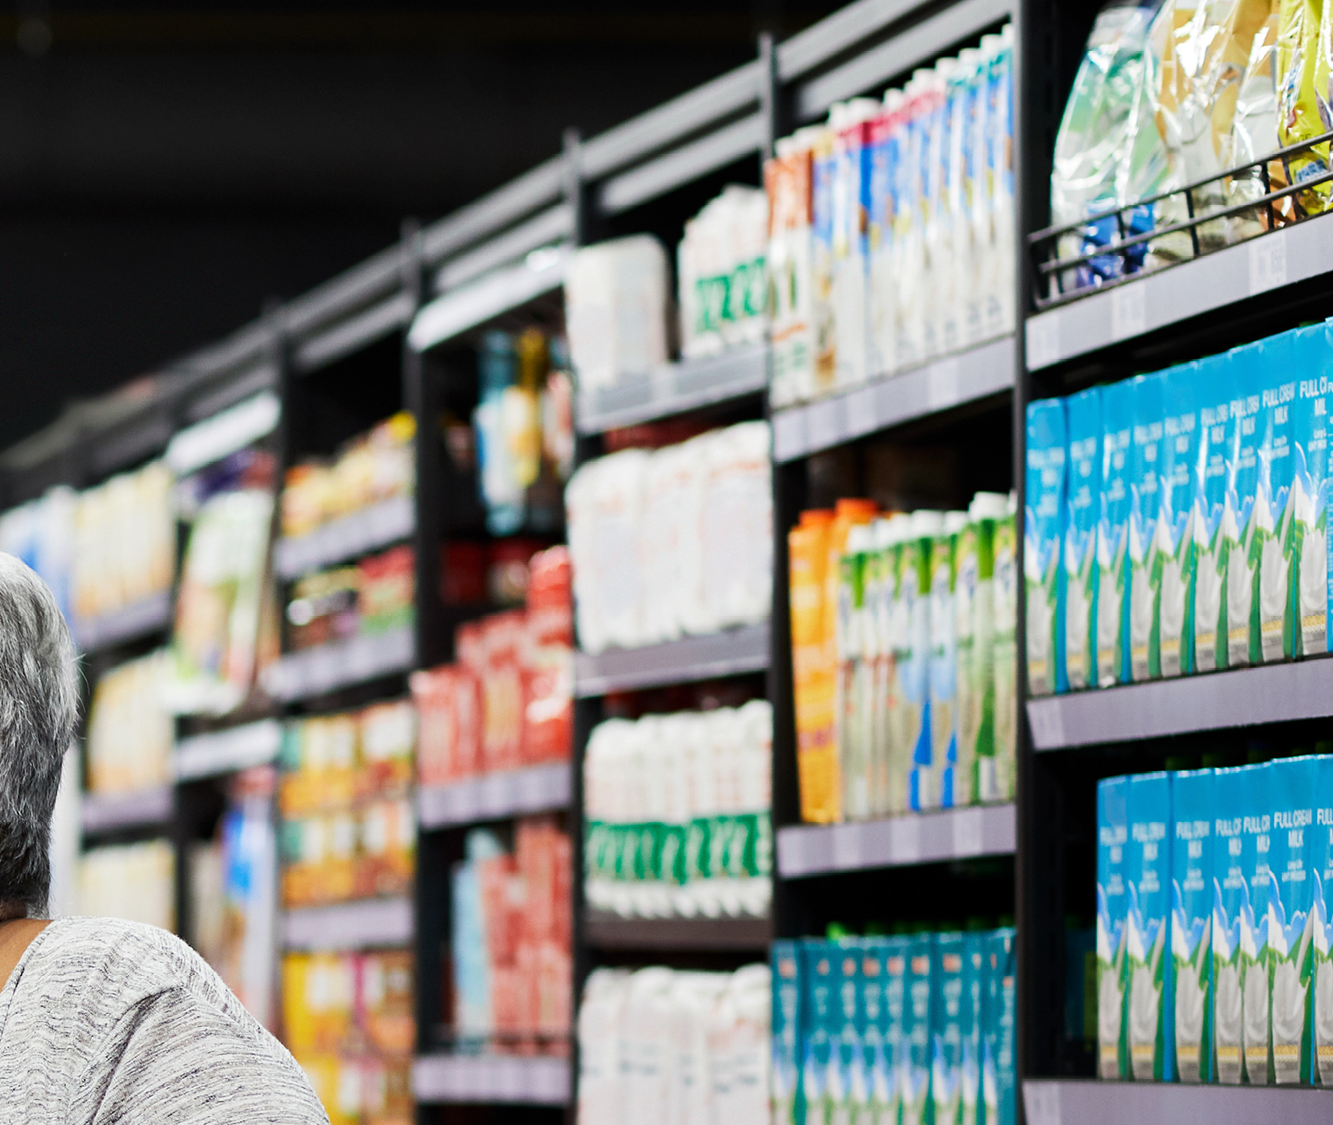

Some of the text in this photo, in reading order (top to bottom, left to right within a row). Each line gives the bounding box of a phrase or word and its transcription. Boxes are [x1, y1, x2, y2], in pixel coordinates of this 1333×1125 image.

[1262, 389, 1279, 408] FULL
[1300, 379, 1320, 399] FULL
[1274, 405, 1289, 426] MILK
[1243, 816, 1261, 834] FULL
[1274, 811, 1293, 829] FULL
[1317, 808, 1333, 825] FULL
[1288, 829, 1304, 849] MILK
